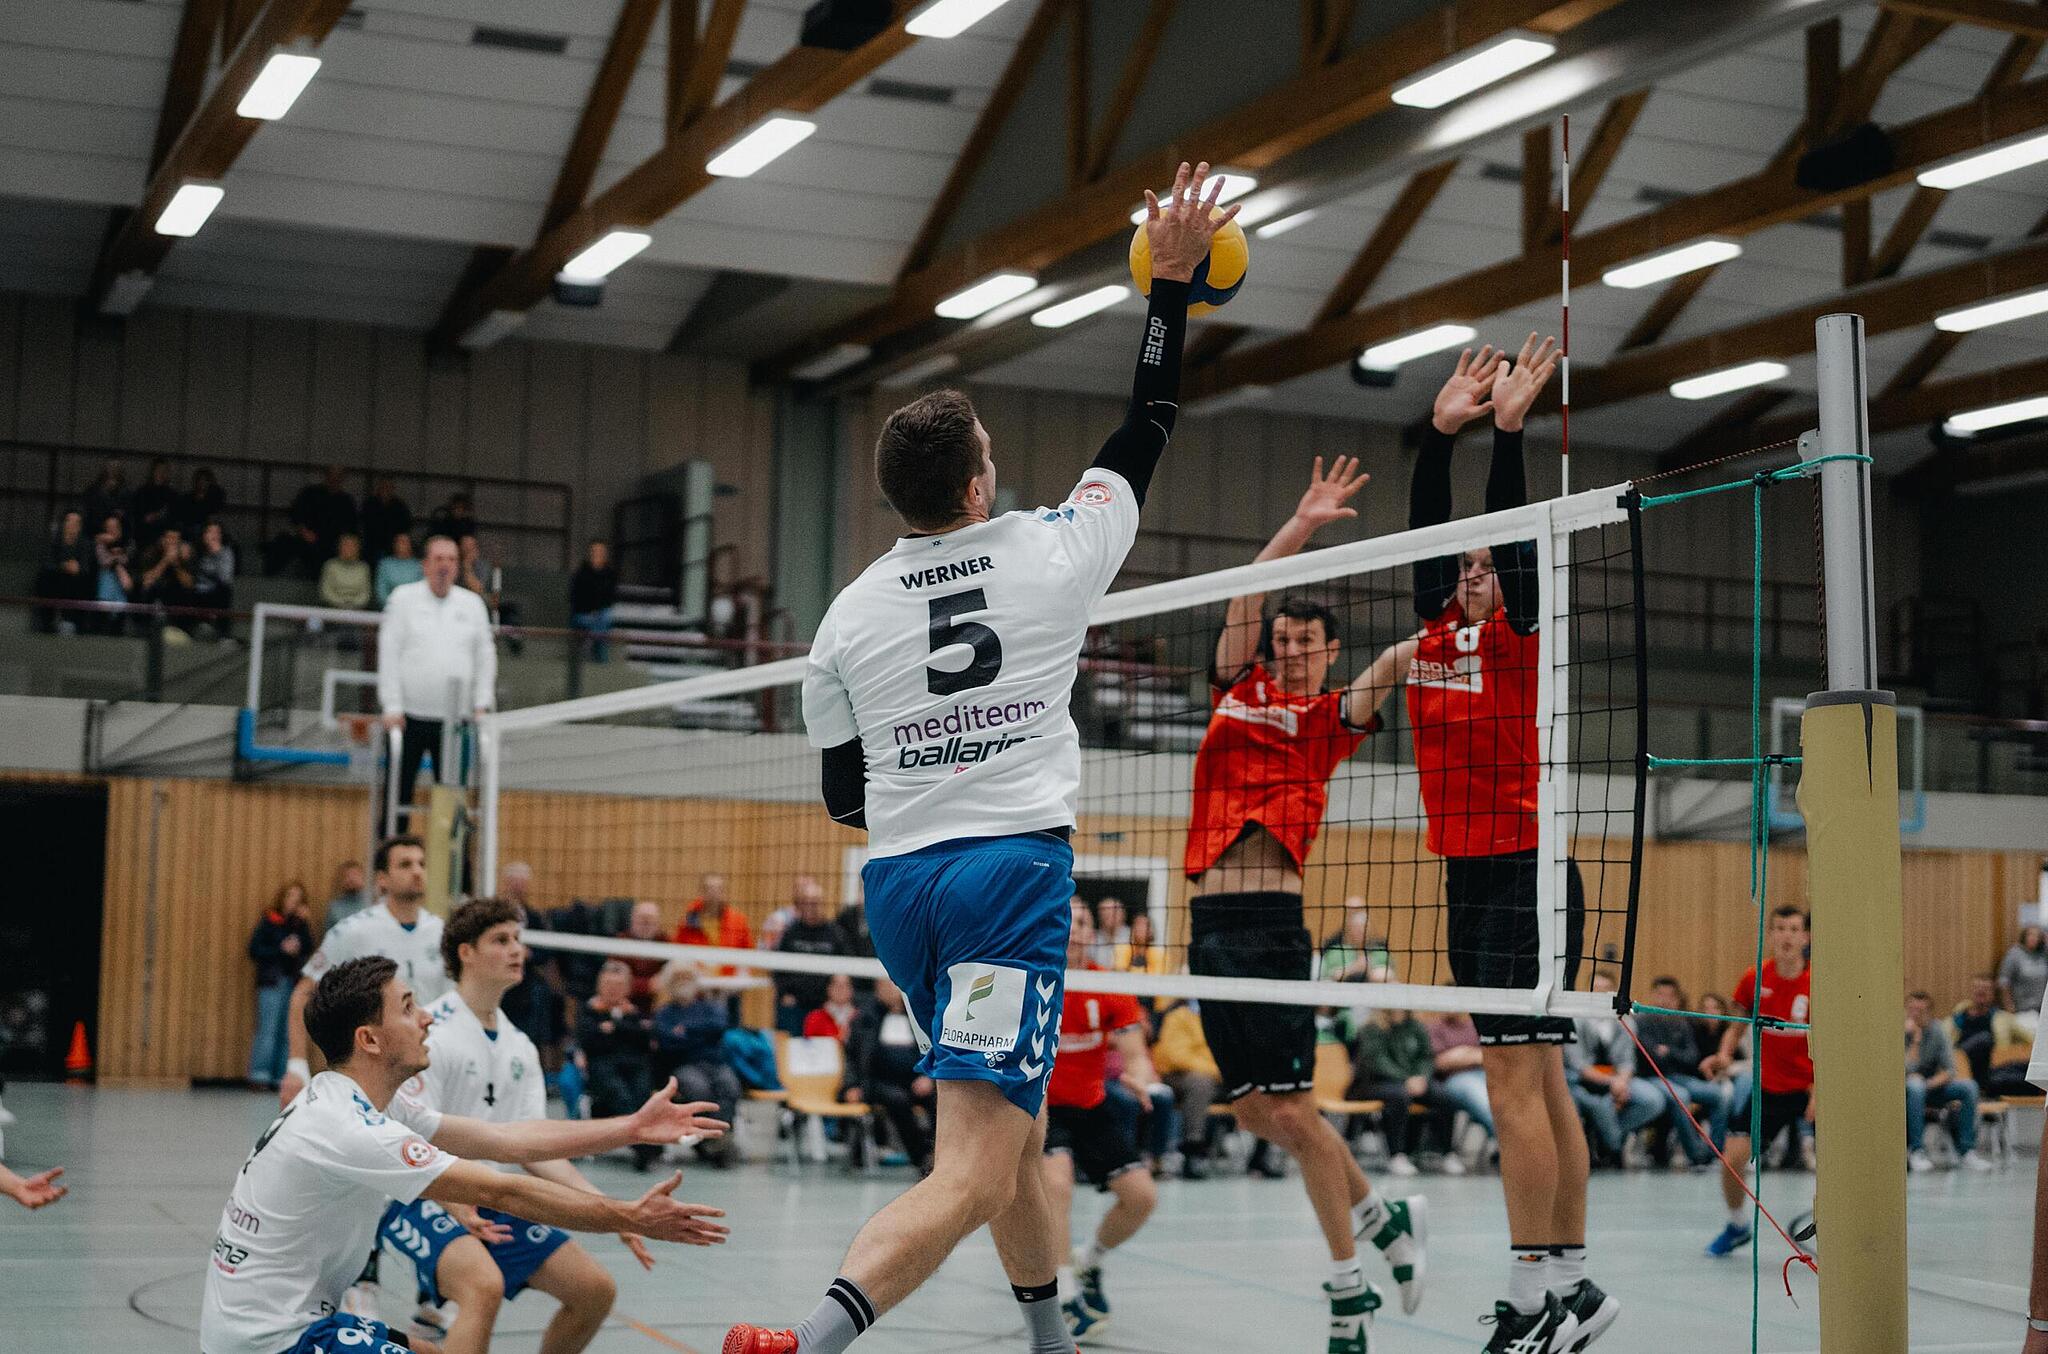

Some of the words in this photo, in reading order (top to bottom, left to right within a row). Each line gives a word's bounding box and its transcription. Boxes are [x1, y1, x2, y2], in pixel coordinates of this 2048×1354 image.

[1147, 316, 1168, 348] cep
[900, 556, 994, 589] WERNER
[926, 587, 1002, 696] 5
[893, 699, 1046, 745] mediteam
[1085, 999, 1099, 1029] 1
[942, 1027, 1014, 1048] FLORAPHARM
